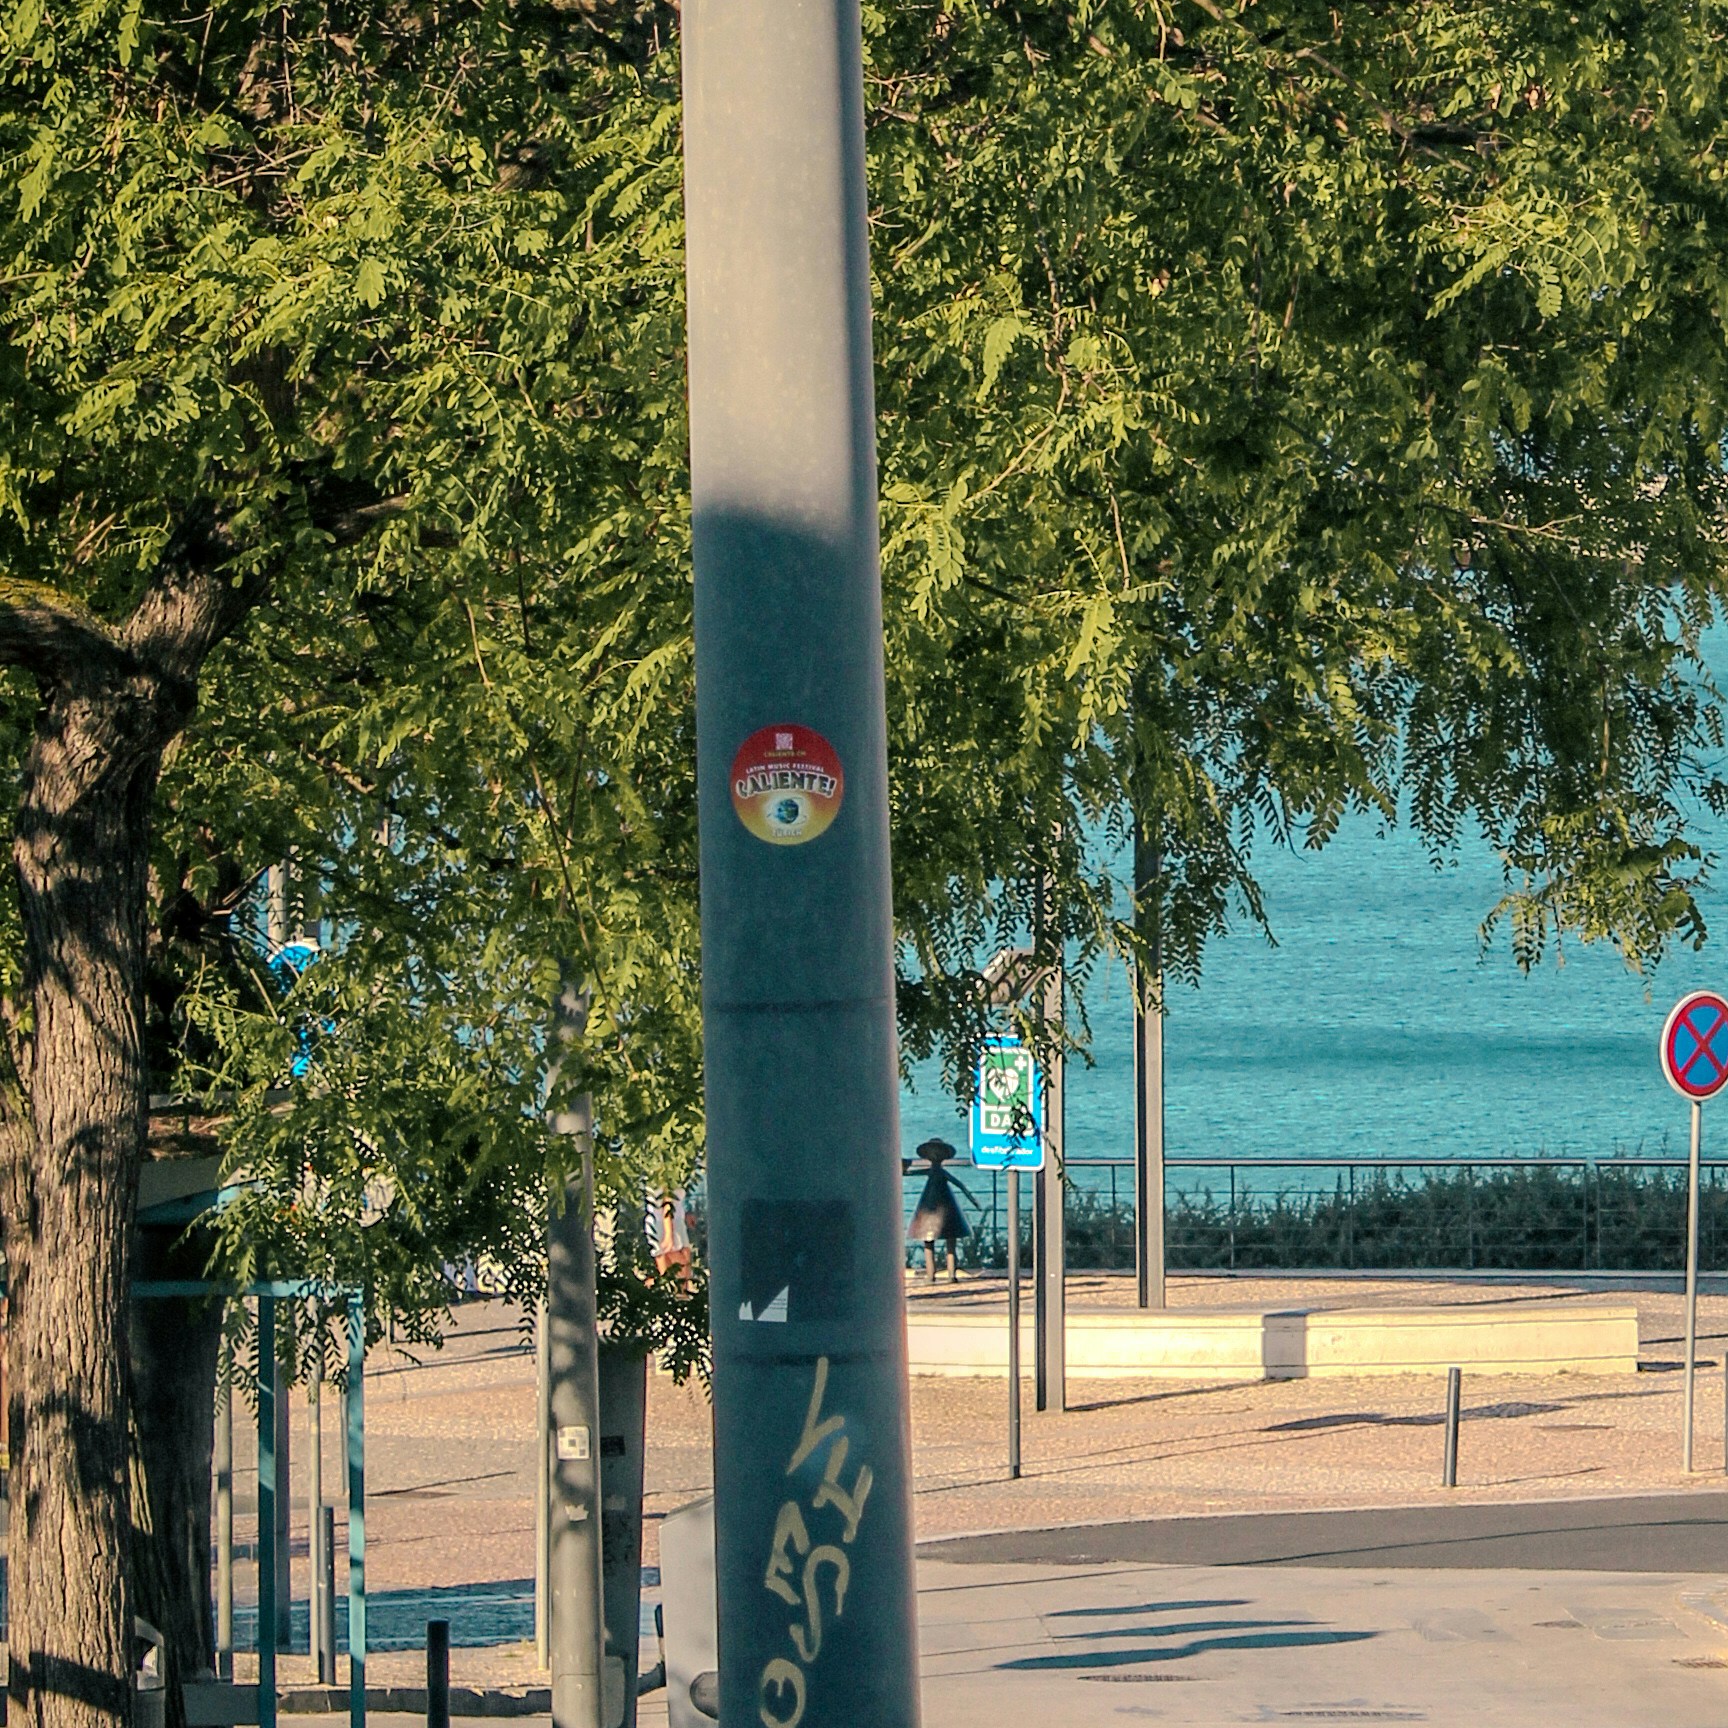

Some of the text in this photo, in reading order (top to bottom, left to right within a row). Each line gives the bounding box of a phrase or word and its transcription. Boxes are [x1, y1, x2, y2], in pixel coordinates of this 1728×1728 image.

[746, 765, 766, 774] LATIN
[792, 762, 824, 773] FESTIVAL
[736, 770, 837, 799] CALIENTE!
